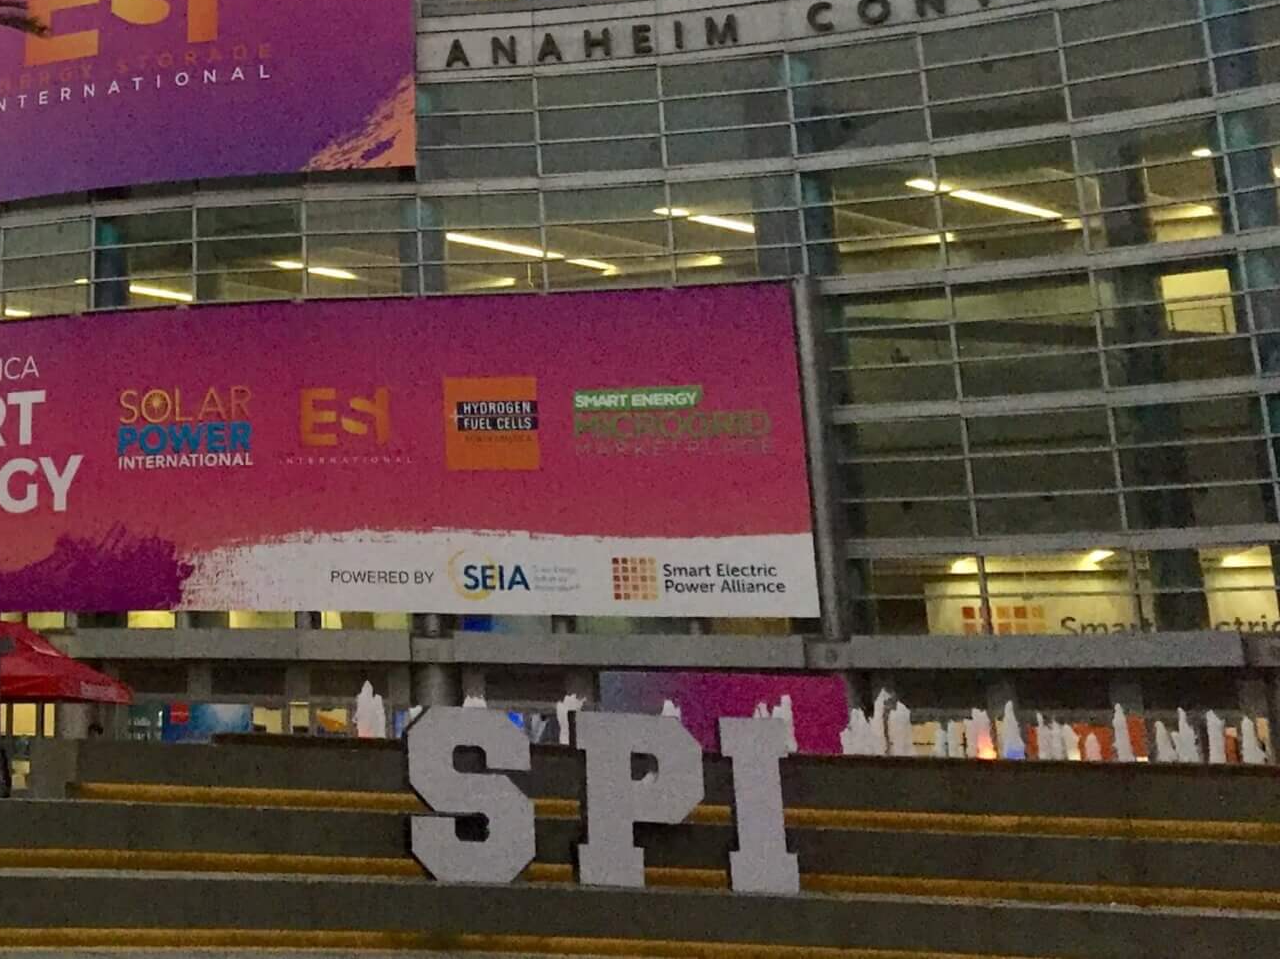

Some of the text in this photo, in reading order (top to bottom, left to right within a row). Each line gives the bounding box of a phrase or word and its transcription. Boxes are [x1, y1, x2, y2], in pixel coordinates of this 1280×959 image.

[446, 14, 738, 67] ANAHEIM
[119, 385, 251, 425] SOLAR
[575, 392, 697, 407] SMART ENERGY
[463, 402, 531, 414] HYDROGEN
[464, 417, 532, 430] FUEL CELLS
[118, 421, 252, 456] POWER
[118, 452, 253, 470] INTERNATIONAL
[330, 570, 435, 585] POWERED BY
[463, 564, 530, 591] SEIA
[663, 563, 777, 577] Smart Electric
[664, 578, 786, 593] Power Alliance
[407, 705, 800, 894] SPI
